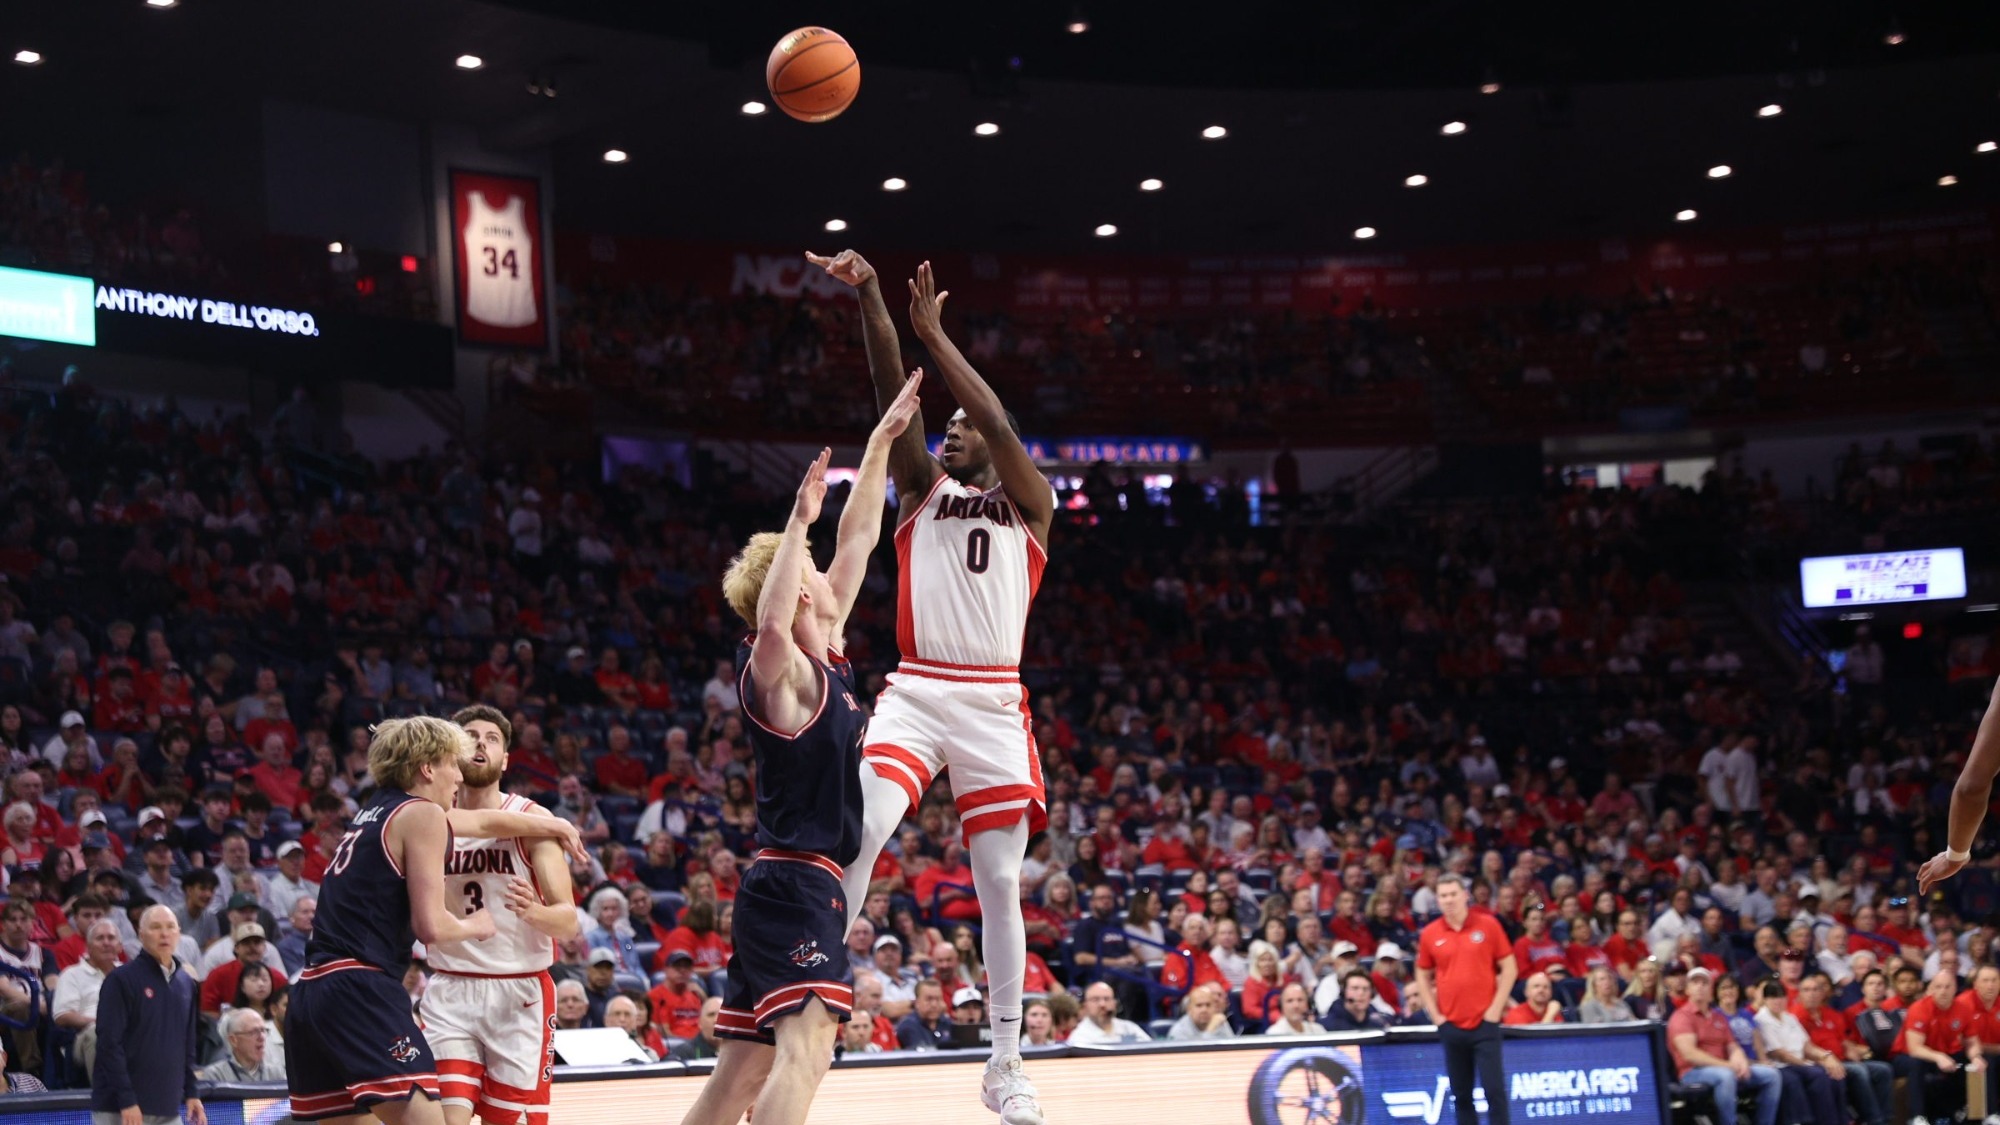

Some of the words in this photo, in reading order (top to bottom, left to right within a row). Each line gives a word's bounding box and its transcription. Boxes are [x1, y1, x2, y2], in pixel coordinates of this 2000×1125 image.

[483, 246, 518, 279] 34
[96, 286, 198, 320] ANTHONY
[201, 299, 319, 337] DELL'ORSO.
[1059, 443, 1180, 462] WILDCATS
[933, 494, 1013, 528] ARIZONA
[966, 527, 991, 574] 0
[444, 848, 516, 876] IZONA
[463, 881, 484, 915] 3
[1511, 1069, 1591, 1100] AMERICA
[1589, 1066, 1640, 1095] FIRST
[1525, 1100, 1580, 1118] CREDIT
[1585, 1097, 1632, 1114] UNION
